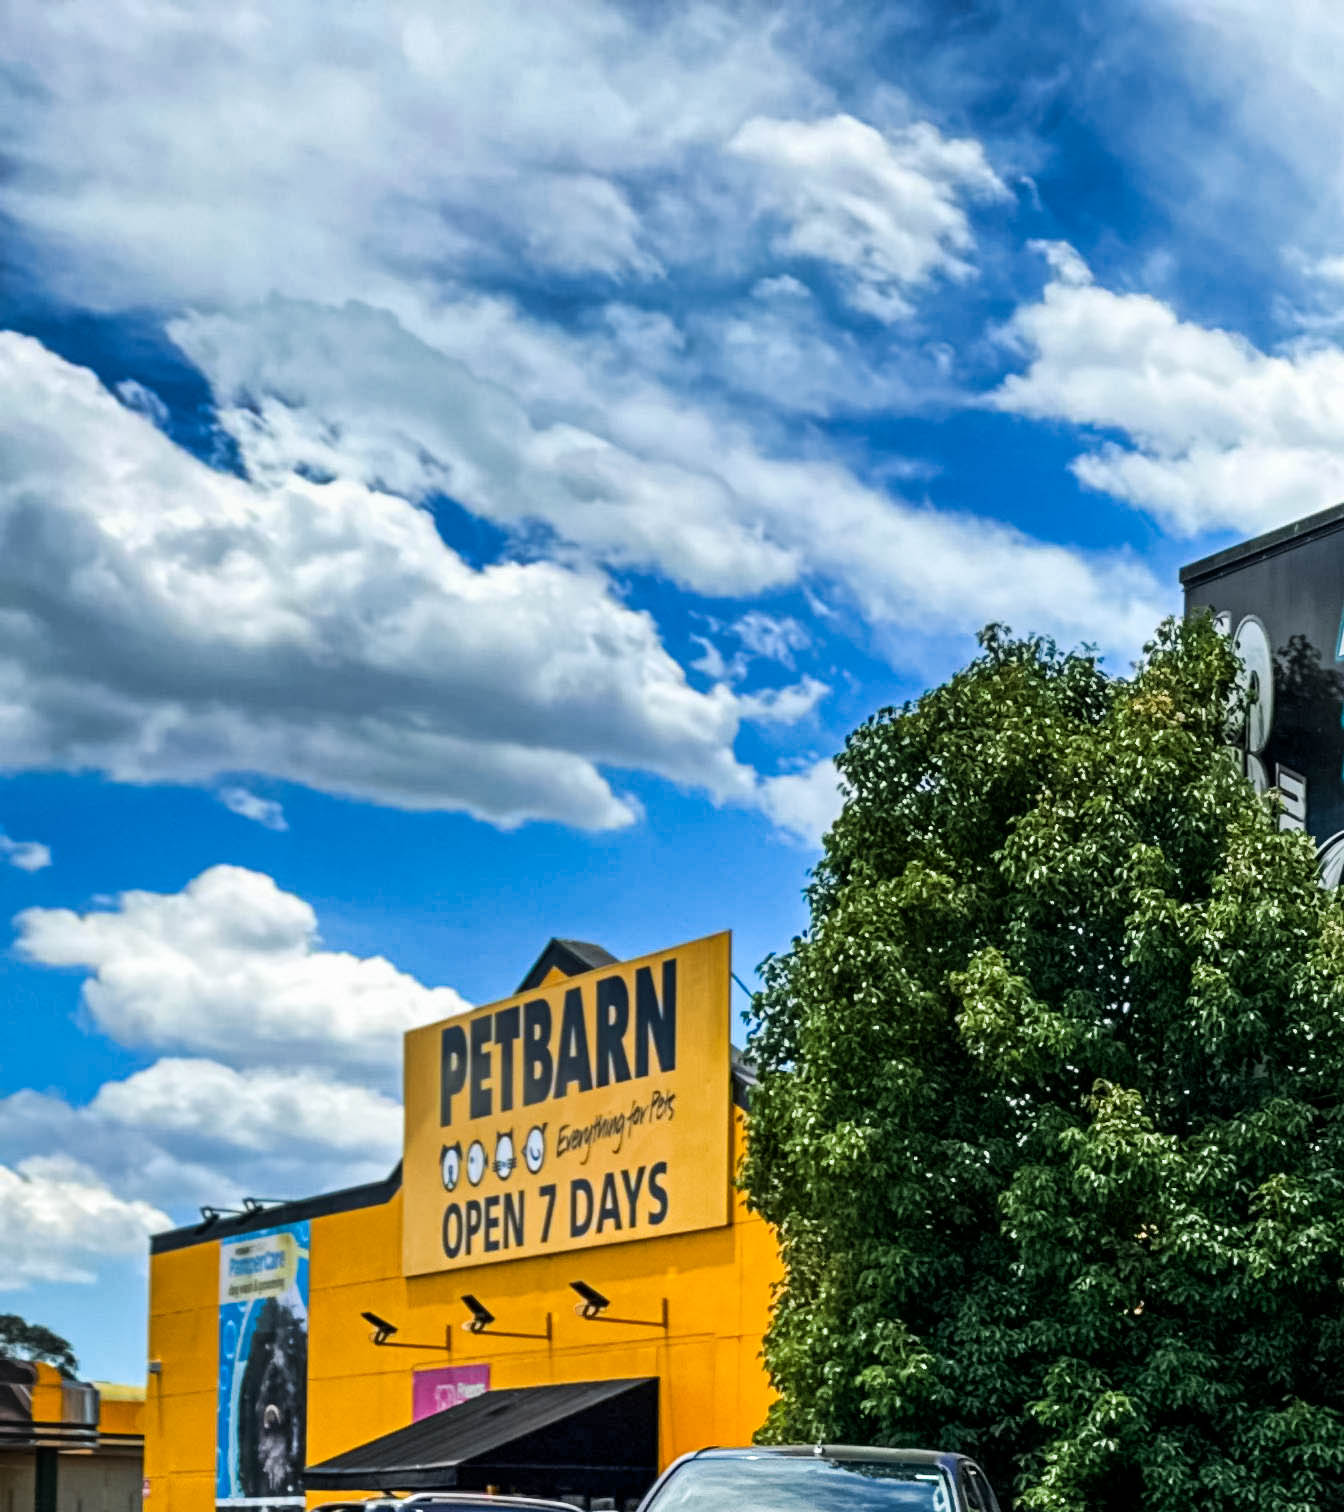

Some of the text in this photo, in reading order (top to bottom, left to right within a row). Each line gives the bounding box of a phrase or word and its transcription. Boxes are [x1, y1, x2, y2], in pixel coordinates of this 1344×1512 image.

[440, 958, 677, 1127] PETBARN
[556, 1089, 676, 1165] Everything for Pets
[442, 1161, 669, 1259] OPEN 7 DAYS
